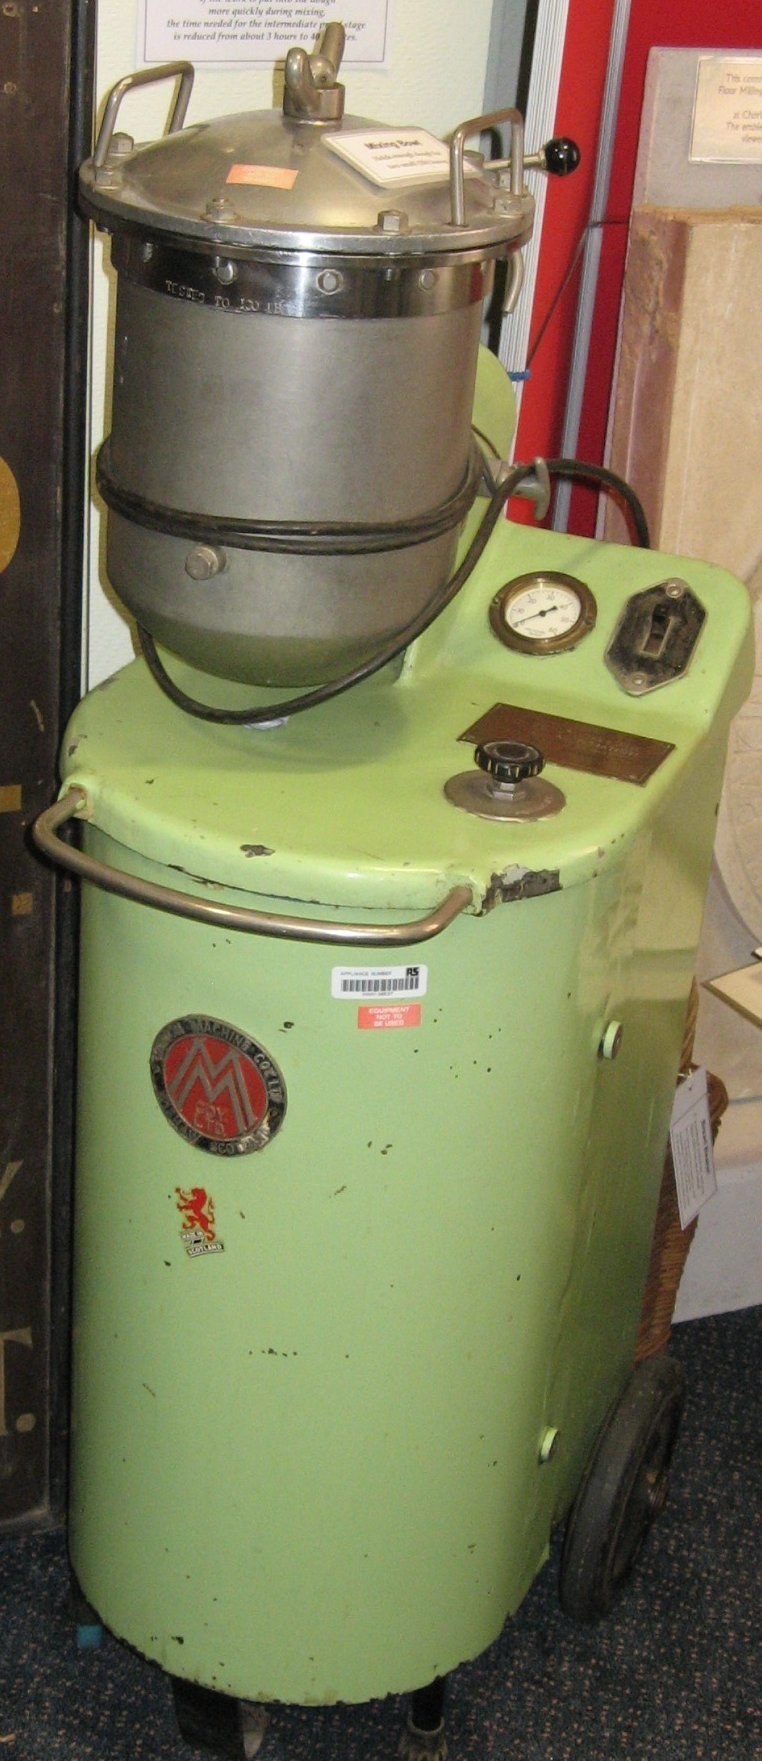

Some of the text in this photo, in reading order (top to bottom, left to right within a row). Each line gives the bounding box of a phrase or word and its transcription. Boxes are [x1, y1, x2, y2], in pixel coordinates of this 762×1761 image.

[208, 6, 325, 18] more quickly during mixing,
[166, 19, 180, 28] the
[182, 20, 201, 28] time
[203, 19, 232, 28] needed
[233, 19, 247, 31] for
[249, 19, 263, 28] the
[264, 19, 318, 28] intermediate
[344, 21, 366, 31] stage
[173, 32, 181, 40] is
[183, 31, 216, 40] reduced
[217, 31, 238, 43] from
[240, 31, 265, 40] about
[274, 31, 297, 40] hours
[300, 32, 308, 40] to
[164, 279, 206, 304] TESTED
[214, 295, 231, 309] TO
[406, 967, 419, 977] RS
[369, 1006, 409, 1014] EQUIPMENT
[385, 1019, 404, 1027] USED
[190, 1018, 252, 1052] MACHINE
